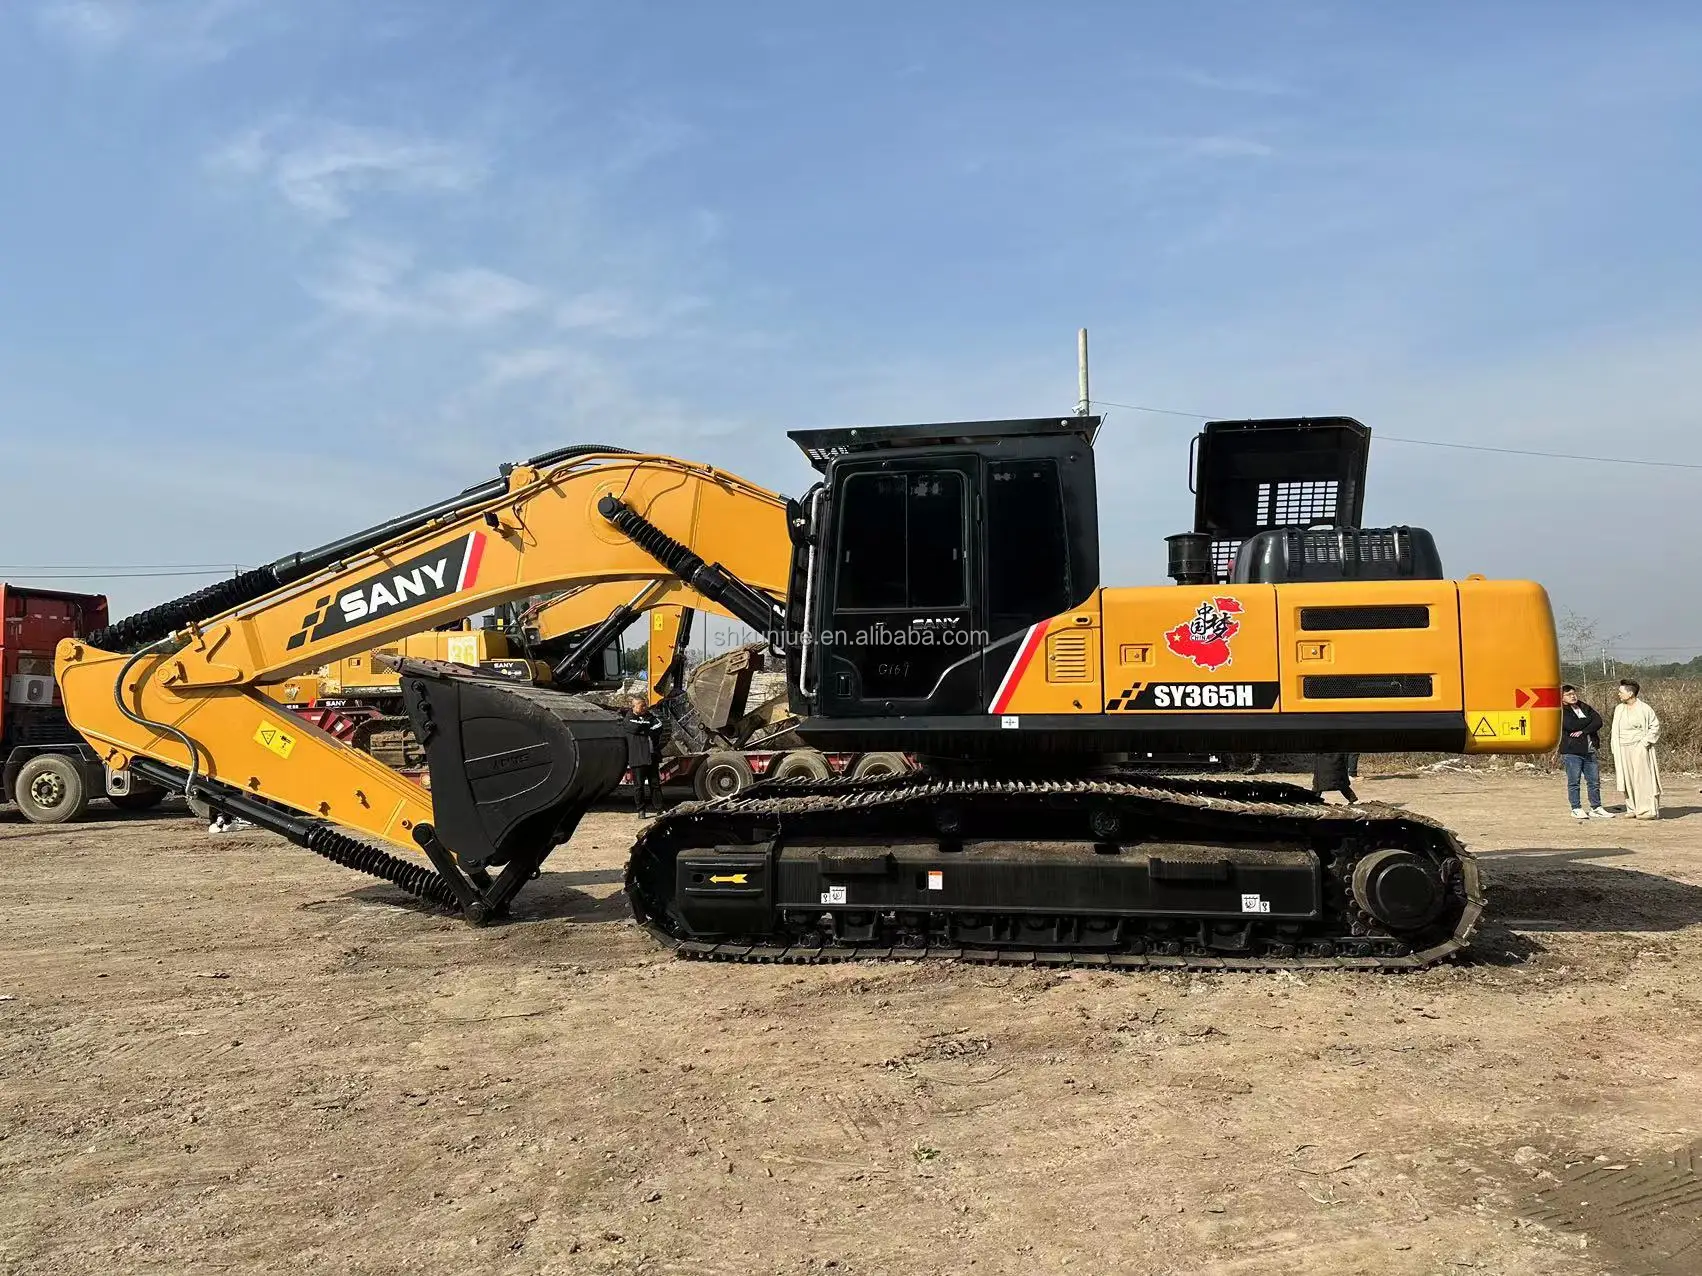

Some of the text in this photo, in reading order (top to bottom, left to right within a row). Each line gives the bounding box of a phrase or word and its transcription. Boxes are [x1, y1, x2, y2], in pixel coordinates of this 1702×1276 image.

[340, 558, 447, 623] SANY
[912, 617, 960, 630] SANY
[1154, 685, 1253, 707] SY365H
